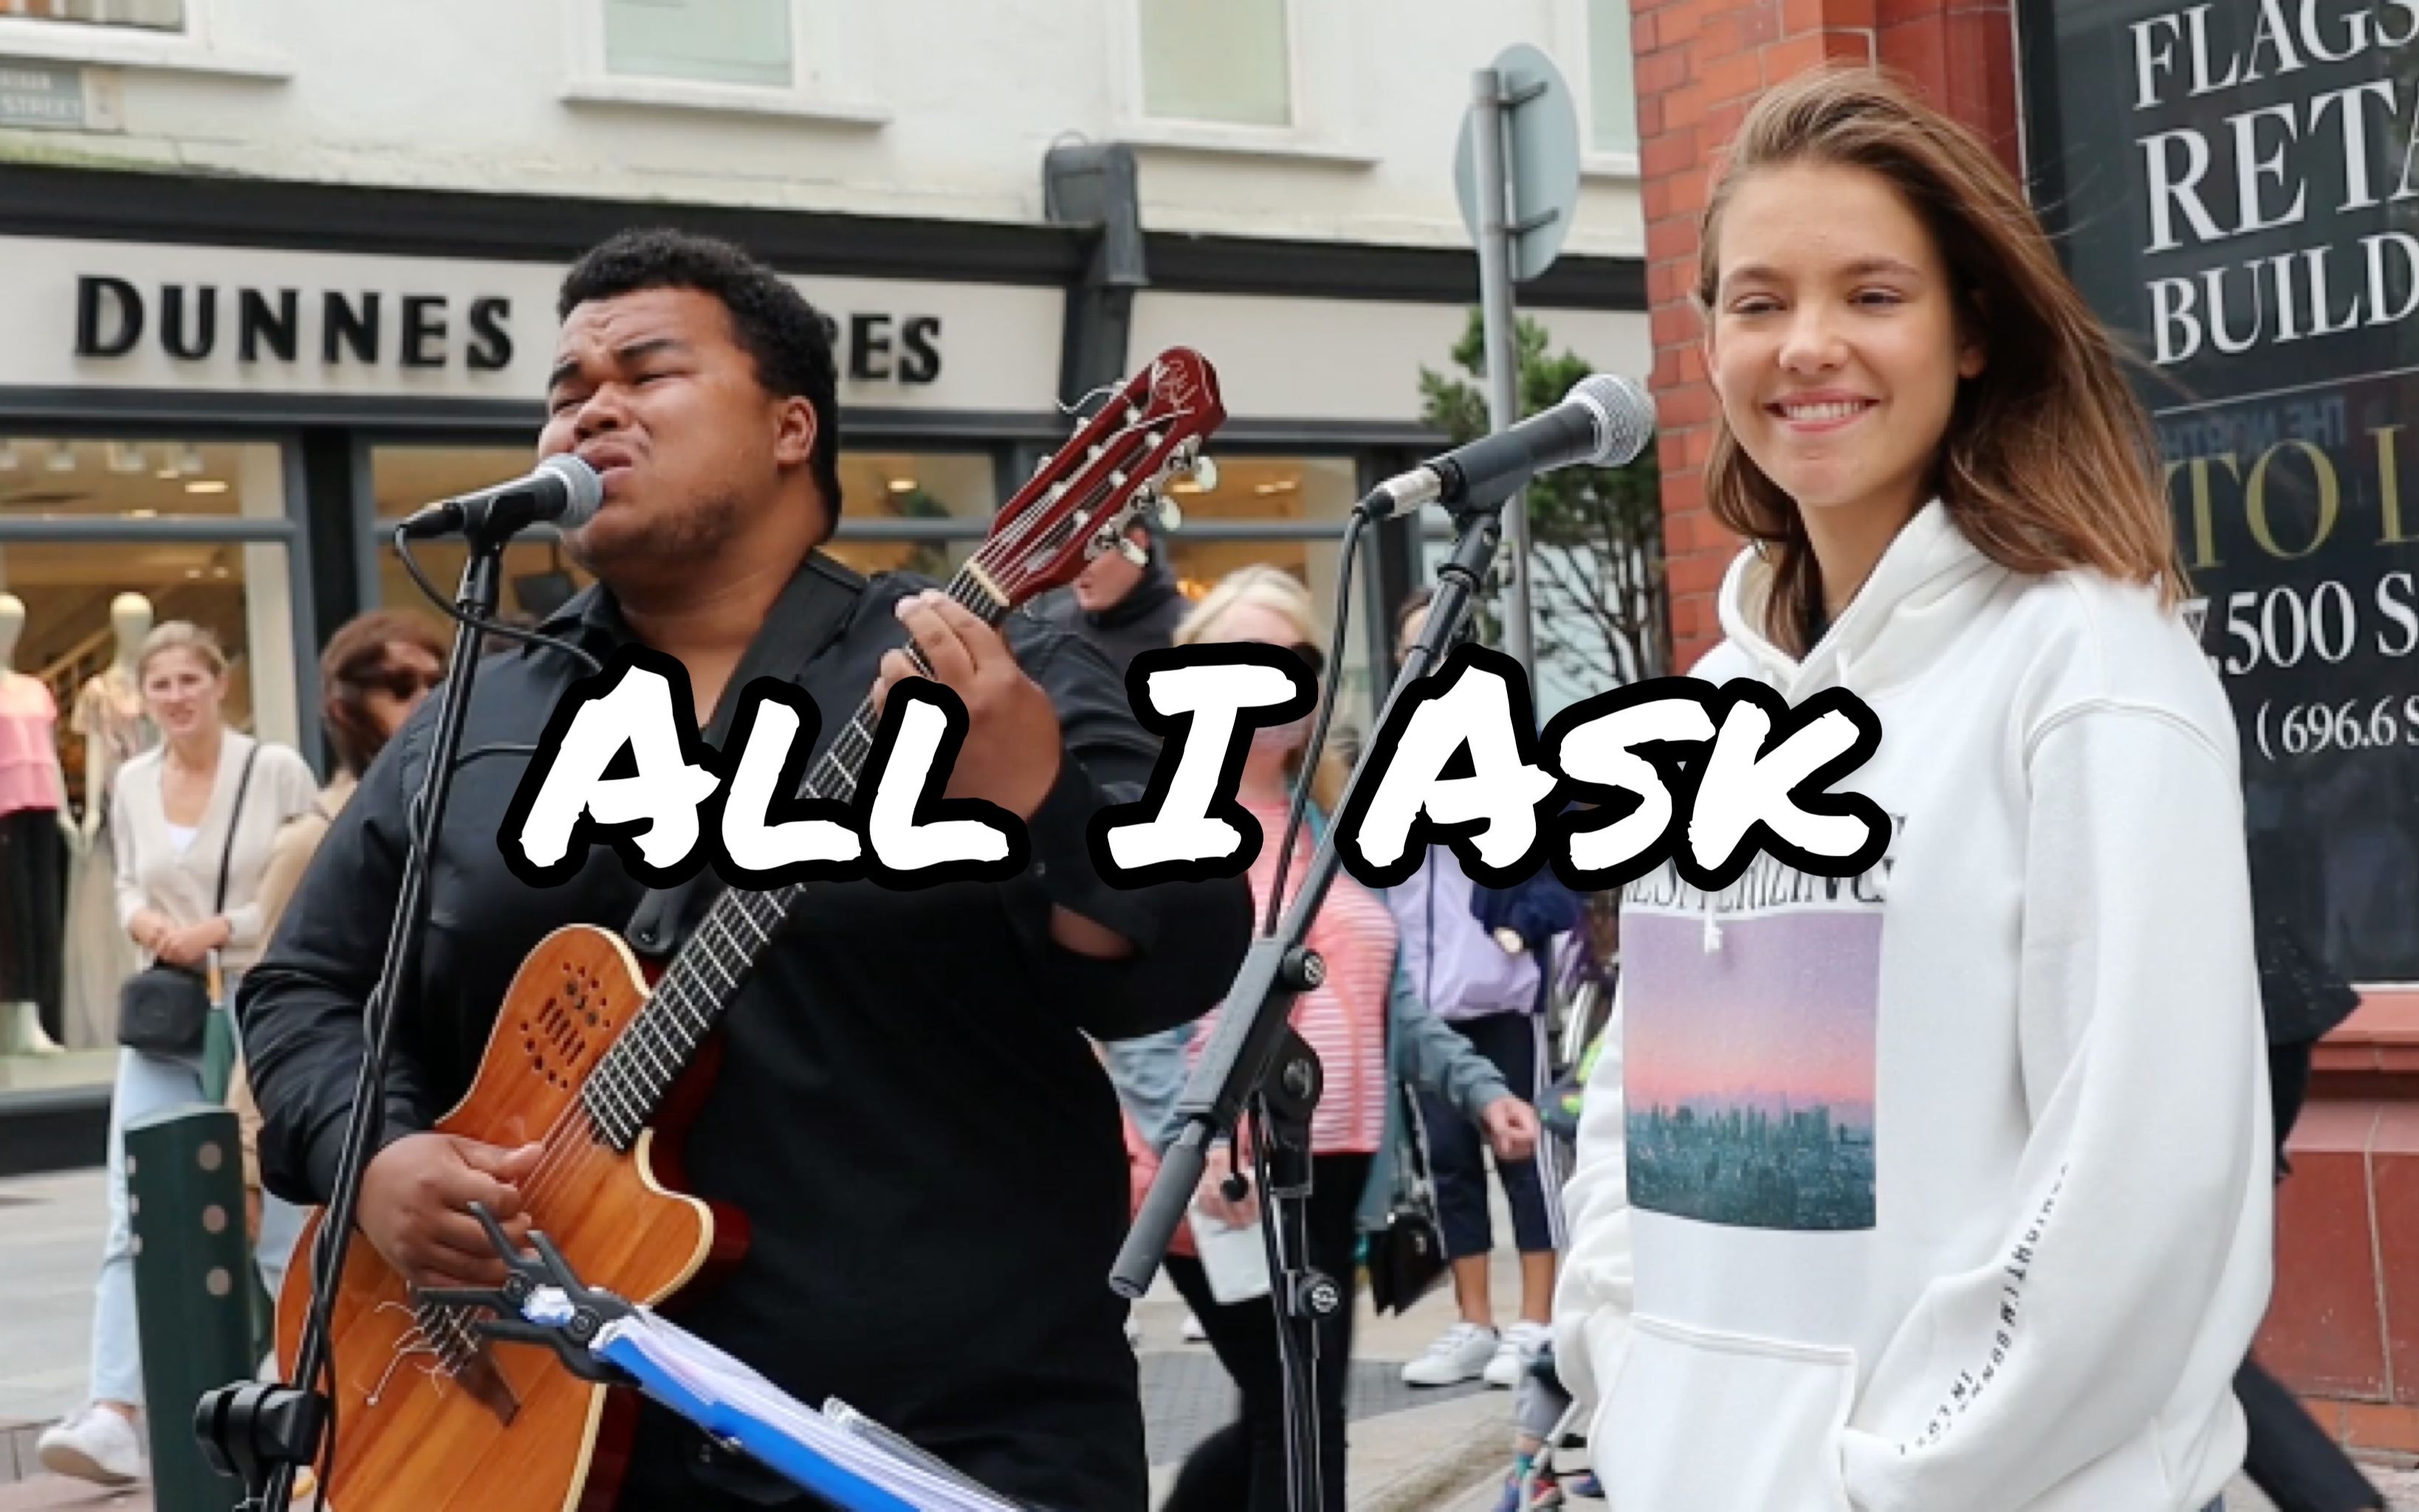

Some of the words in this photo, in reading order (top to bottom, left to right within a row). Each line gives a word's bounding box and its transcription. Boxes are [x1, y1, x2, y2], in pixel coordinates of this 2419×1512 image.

[74, 275, 515, 371] DUNNES
[2147, 231, 2419, 366] BUILD
[2165, 439, 2339, 569] TO
